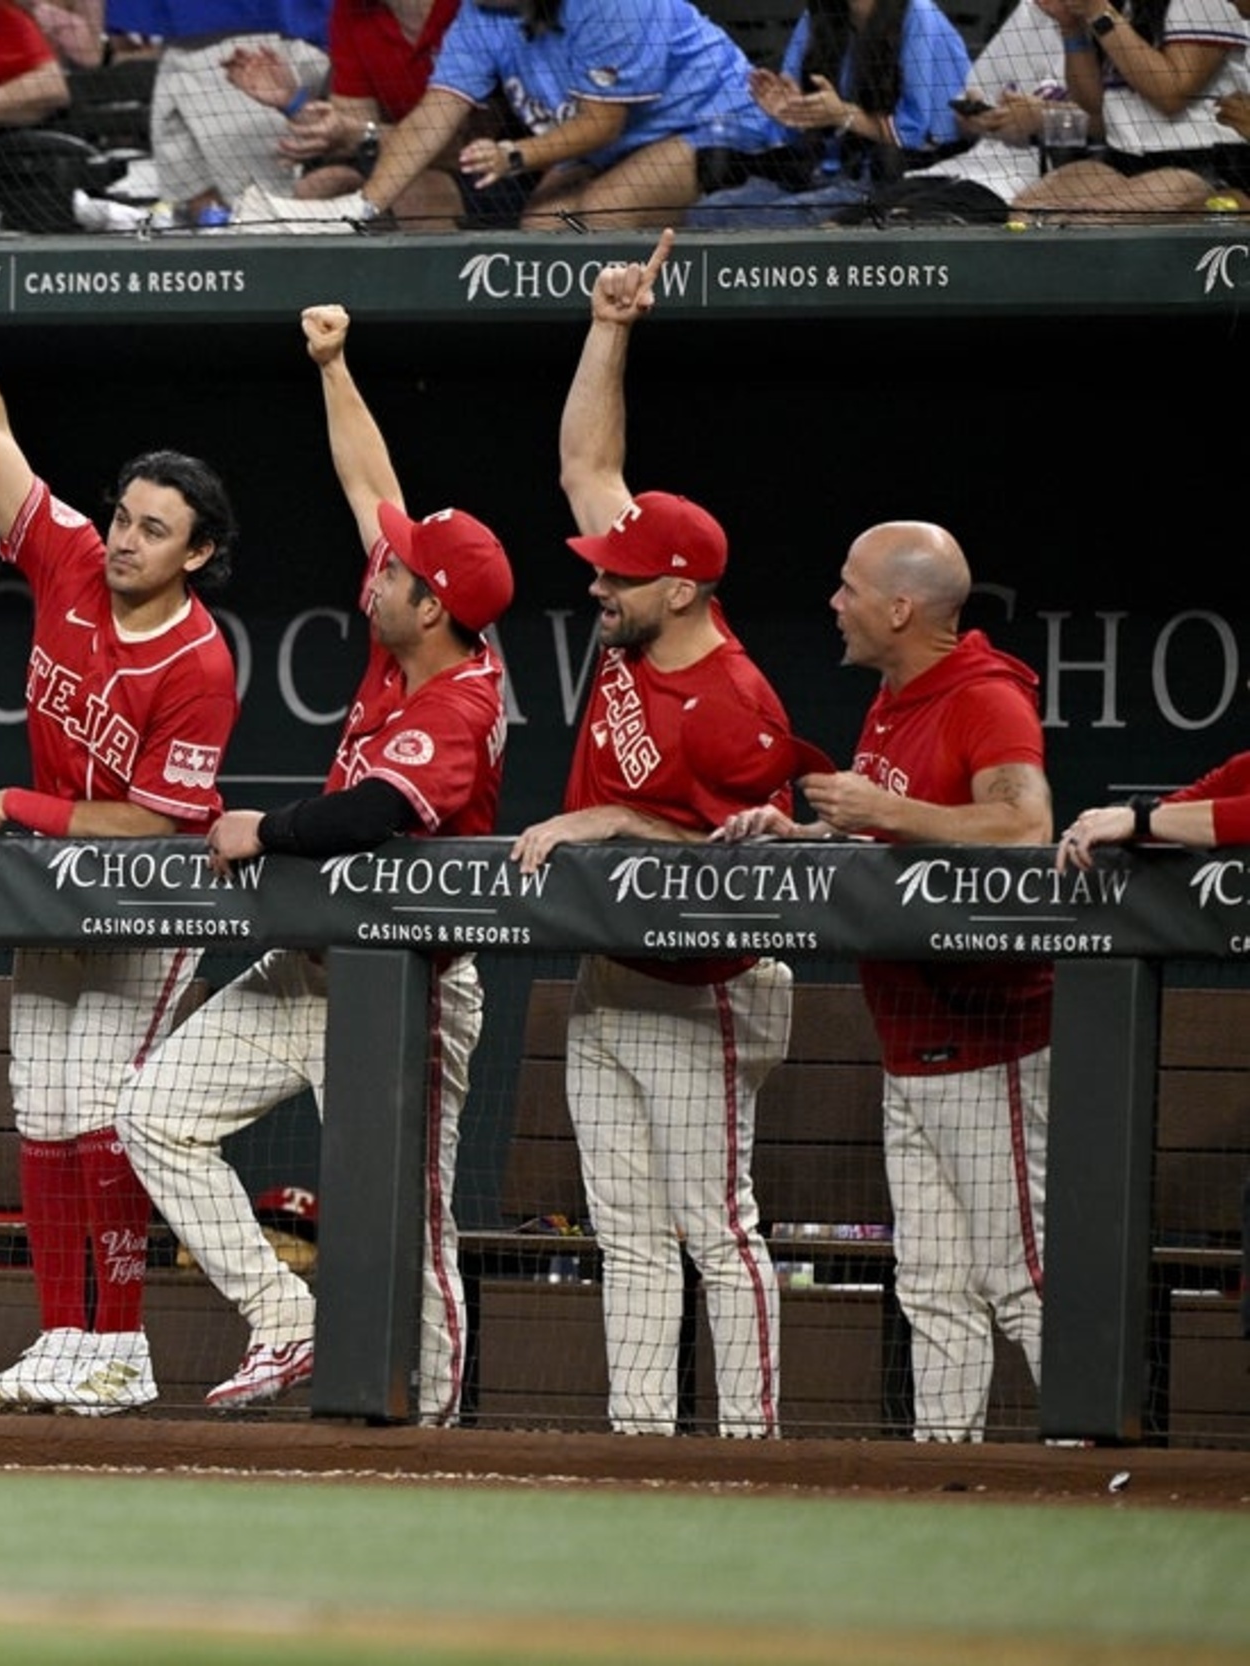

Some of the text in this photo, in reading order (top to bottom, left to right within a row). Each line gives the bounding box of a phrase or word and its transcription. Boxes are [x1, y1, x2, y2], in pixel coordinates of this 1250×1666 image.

[24, 269, 246, 295] CASINOS & RESORTS
[717, 264, 950, 288] CASINOS & RESORTS
[342, 851, 551, 898] CHOCTAW
[632, 855, 837, 902] CHOCTAW
[921, 858, 1132, 905] CHOCTAW
[81, 917, 251, 936] CASINOS & RESORTS
[357, 922, 531, 945] CASINOS & RESORTS
[643, 930, 817, 949] CASINOS & RESORTS
[929, 932, 1113, 952] CASINOS & RESORTS
